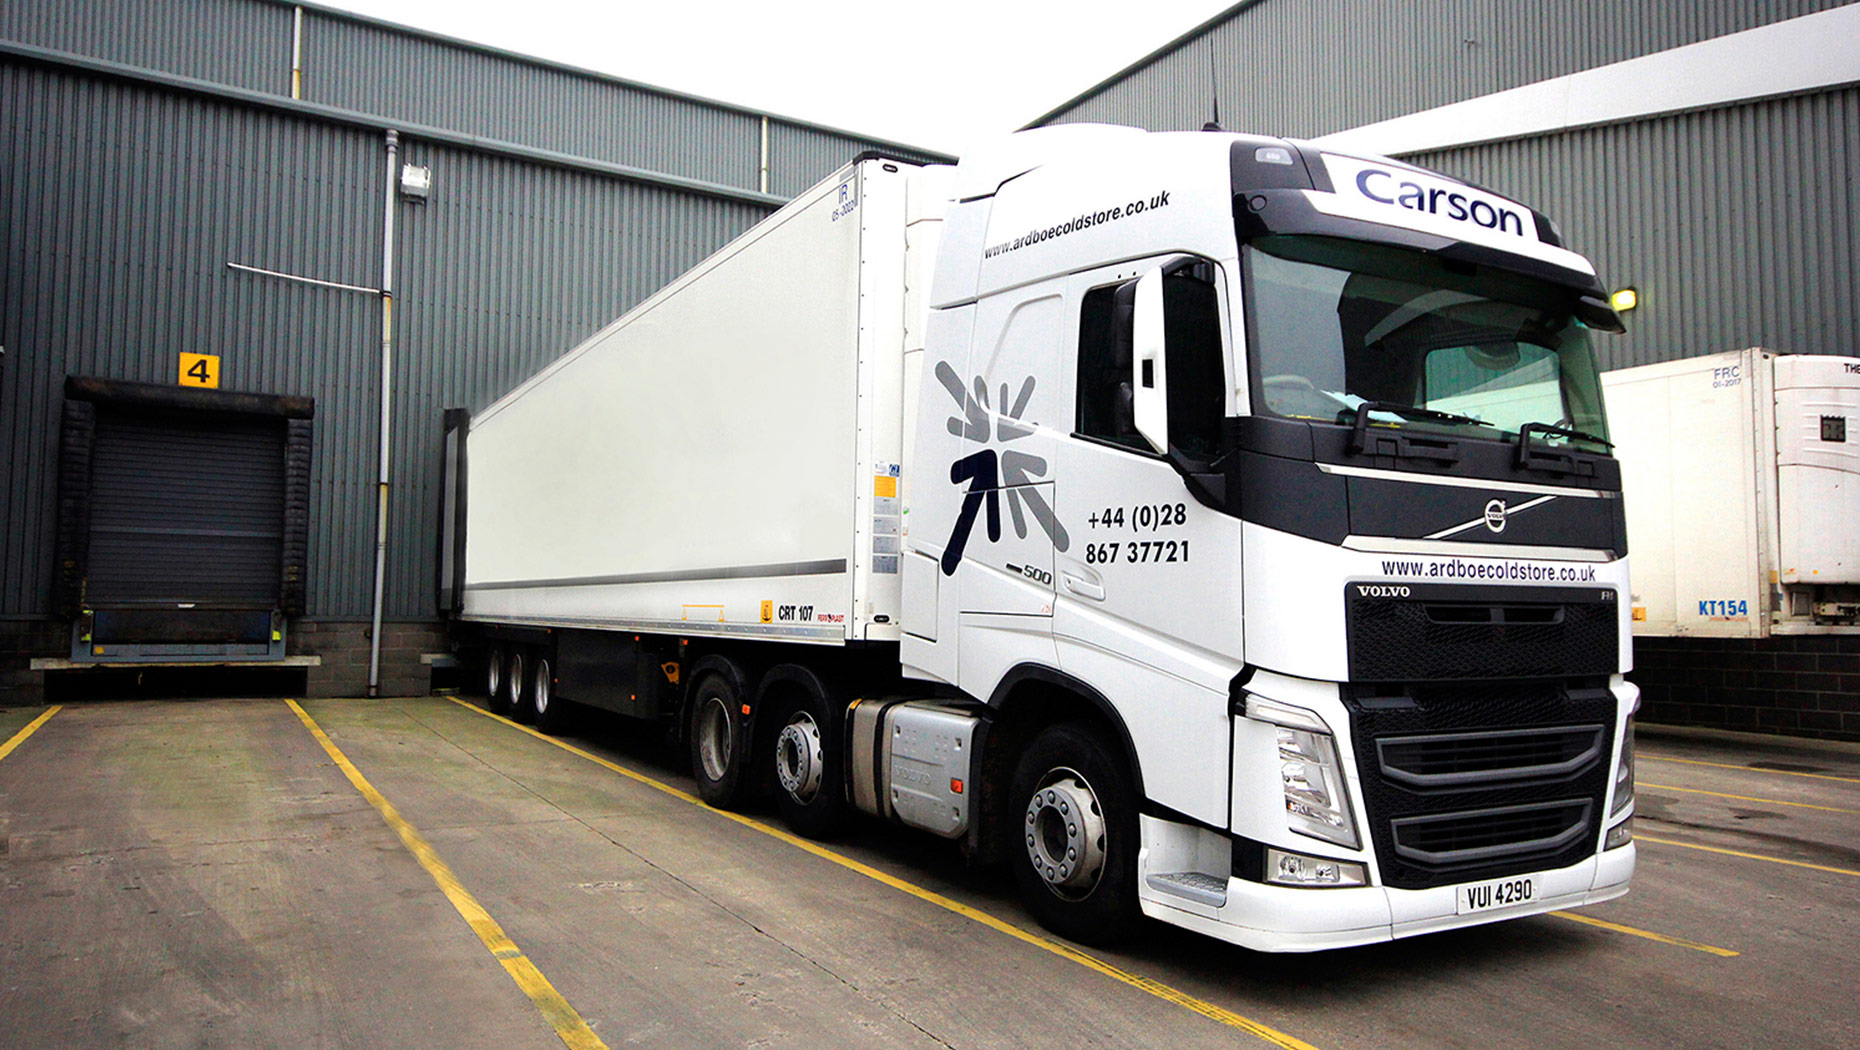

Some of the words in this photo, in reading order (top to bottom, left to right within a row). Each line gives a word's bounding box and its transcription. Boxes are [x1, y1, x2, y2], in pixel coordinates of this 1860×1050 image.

[1356, 169, 1523, 236] Carson
[985, 190, 1170, 259] www.ardboecoldstore.co.uk
[187, 359, 210, 383] 4
[1714, 365, 1740, 379] FRC
[1088, 508, 1125, 529] +44
[1132, 503, 1187, 532] (0)28
[1086, 543, 1120, 564] 867
[1127, 541, 1189, 563] 37721
[1023, 564, 1052, 585] 500
[1382, 559, 1596, 582] www.ardboecoldstore.co.uk
[1357, 585, 1411, 598] VOLVO
[778, 605, 796, 620] CRT
[799, 606, 813, 621] 107
[1698, 600, 1748, 616] KT154
[1468, 885, 1491, 909] VUI
[1495, 879, 1532, 904] 4290
